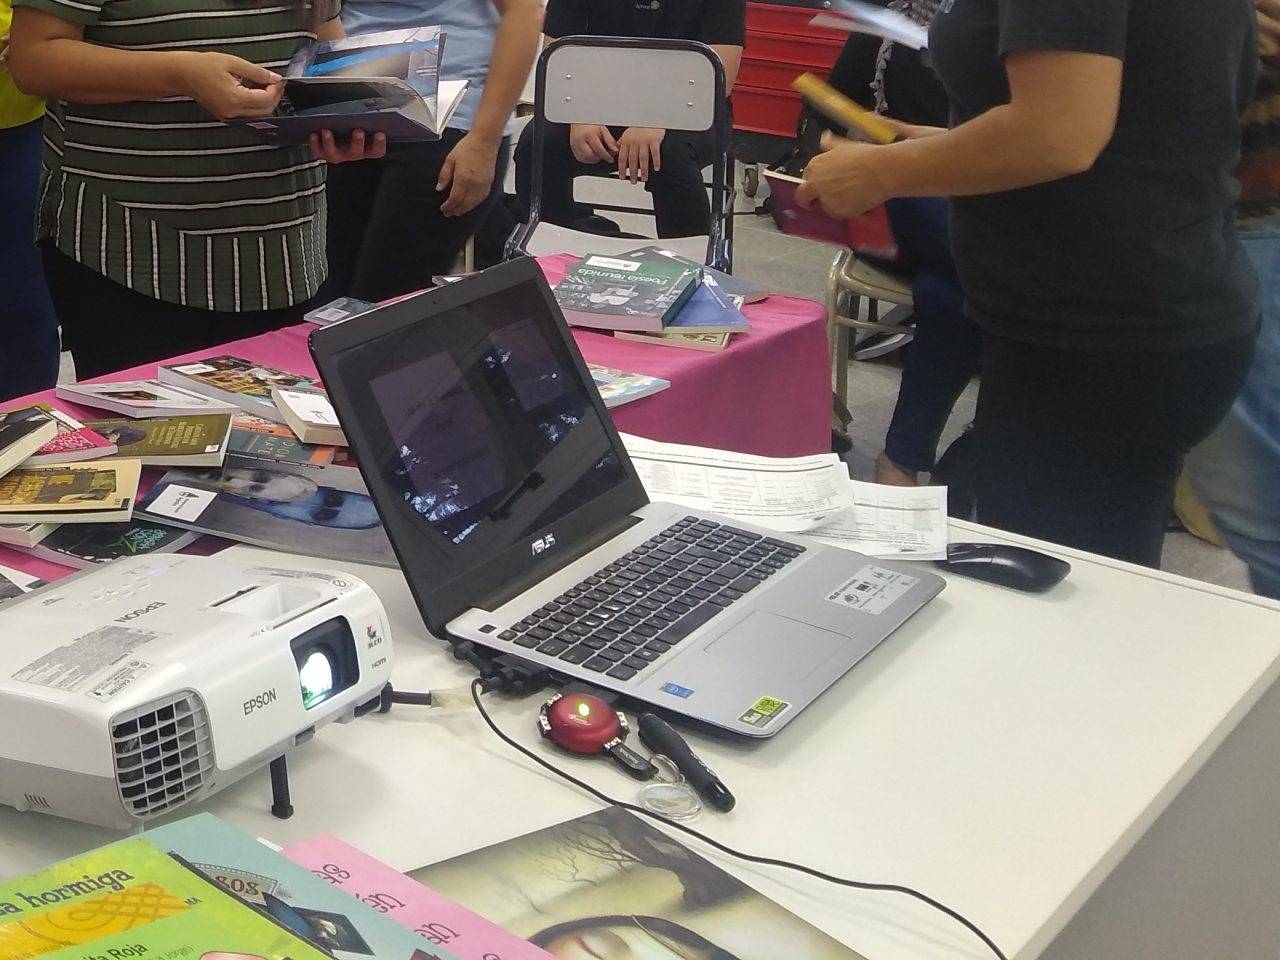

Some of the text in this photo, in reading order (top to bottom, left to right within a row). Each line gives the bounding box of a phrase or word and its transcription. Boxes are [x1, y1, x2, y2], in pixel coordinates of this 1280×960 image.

[114, 601, 167, 624] EPSON
[243, 688, 277, 716] EPSON
[16, 866, 135, 910] hormiga
[107, 942, 148, 960] Roja
